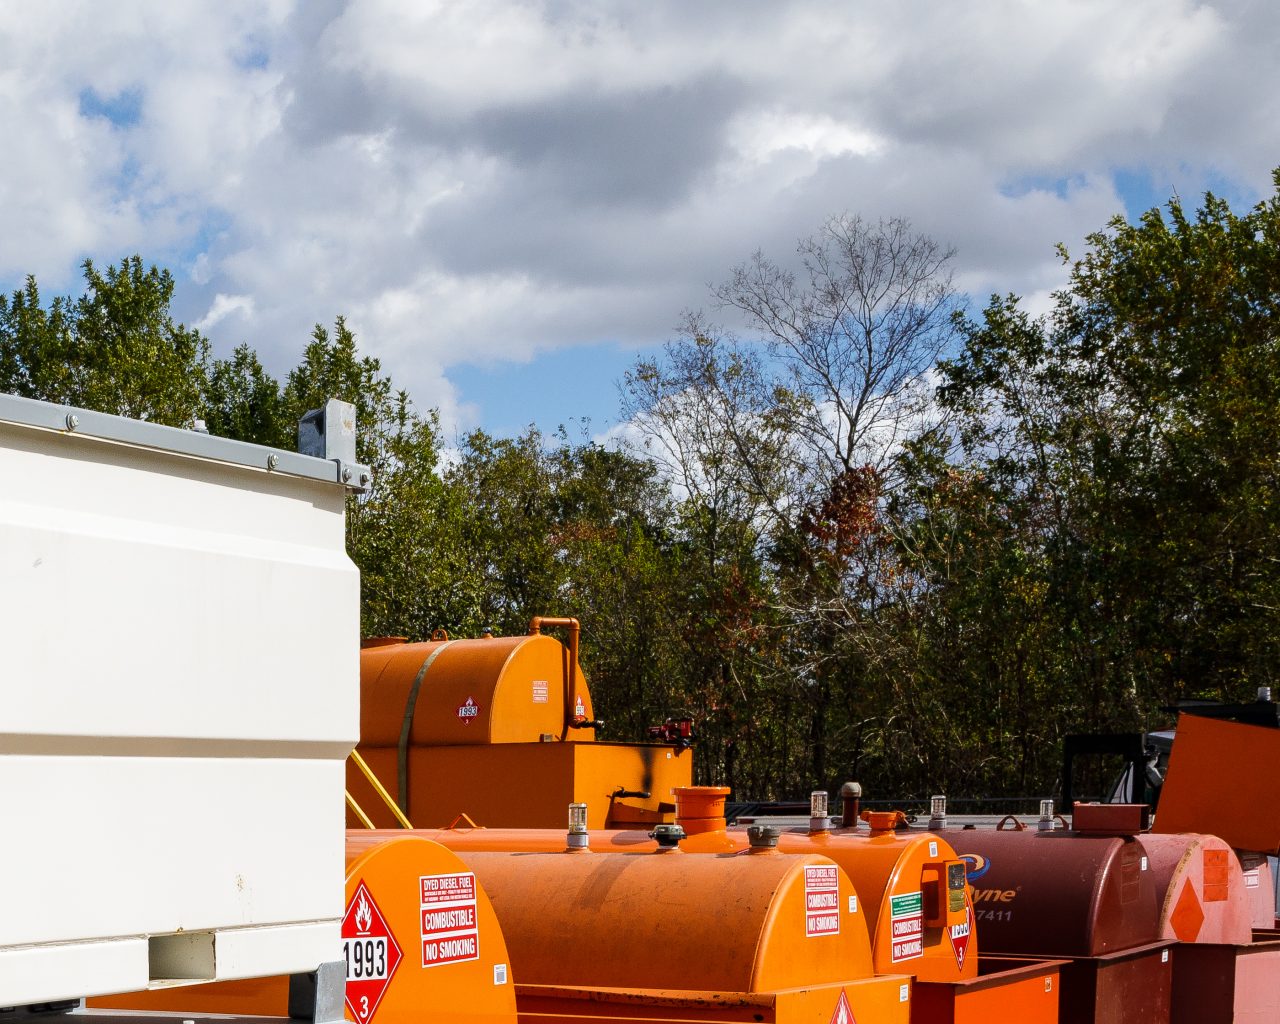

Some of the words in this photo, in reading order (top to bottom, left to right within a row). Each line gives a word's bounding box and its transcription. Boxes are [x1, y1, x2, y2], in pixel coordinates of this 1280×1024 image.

[423, 879, 438, 890] DYED
[440, 877, 458, 889] DIESEL
[459, 876, 472, 888] FUEL
[425, 909, 474, 930] COMBUSTIBLE
[343, 940, 385, 978] 1993
[425, 943, 437, 961] NO
[439, 938, 475, 959] SMOKING
[359, 995, 369, 1019] 3
